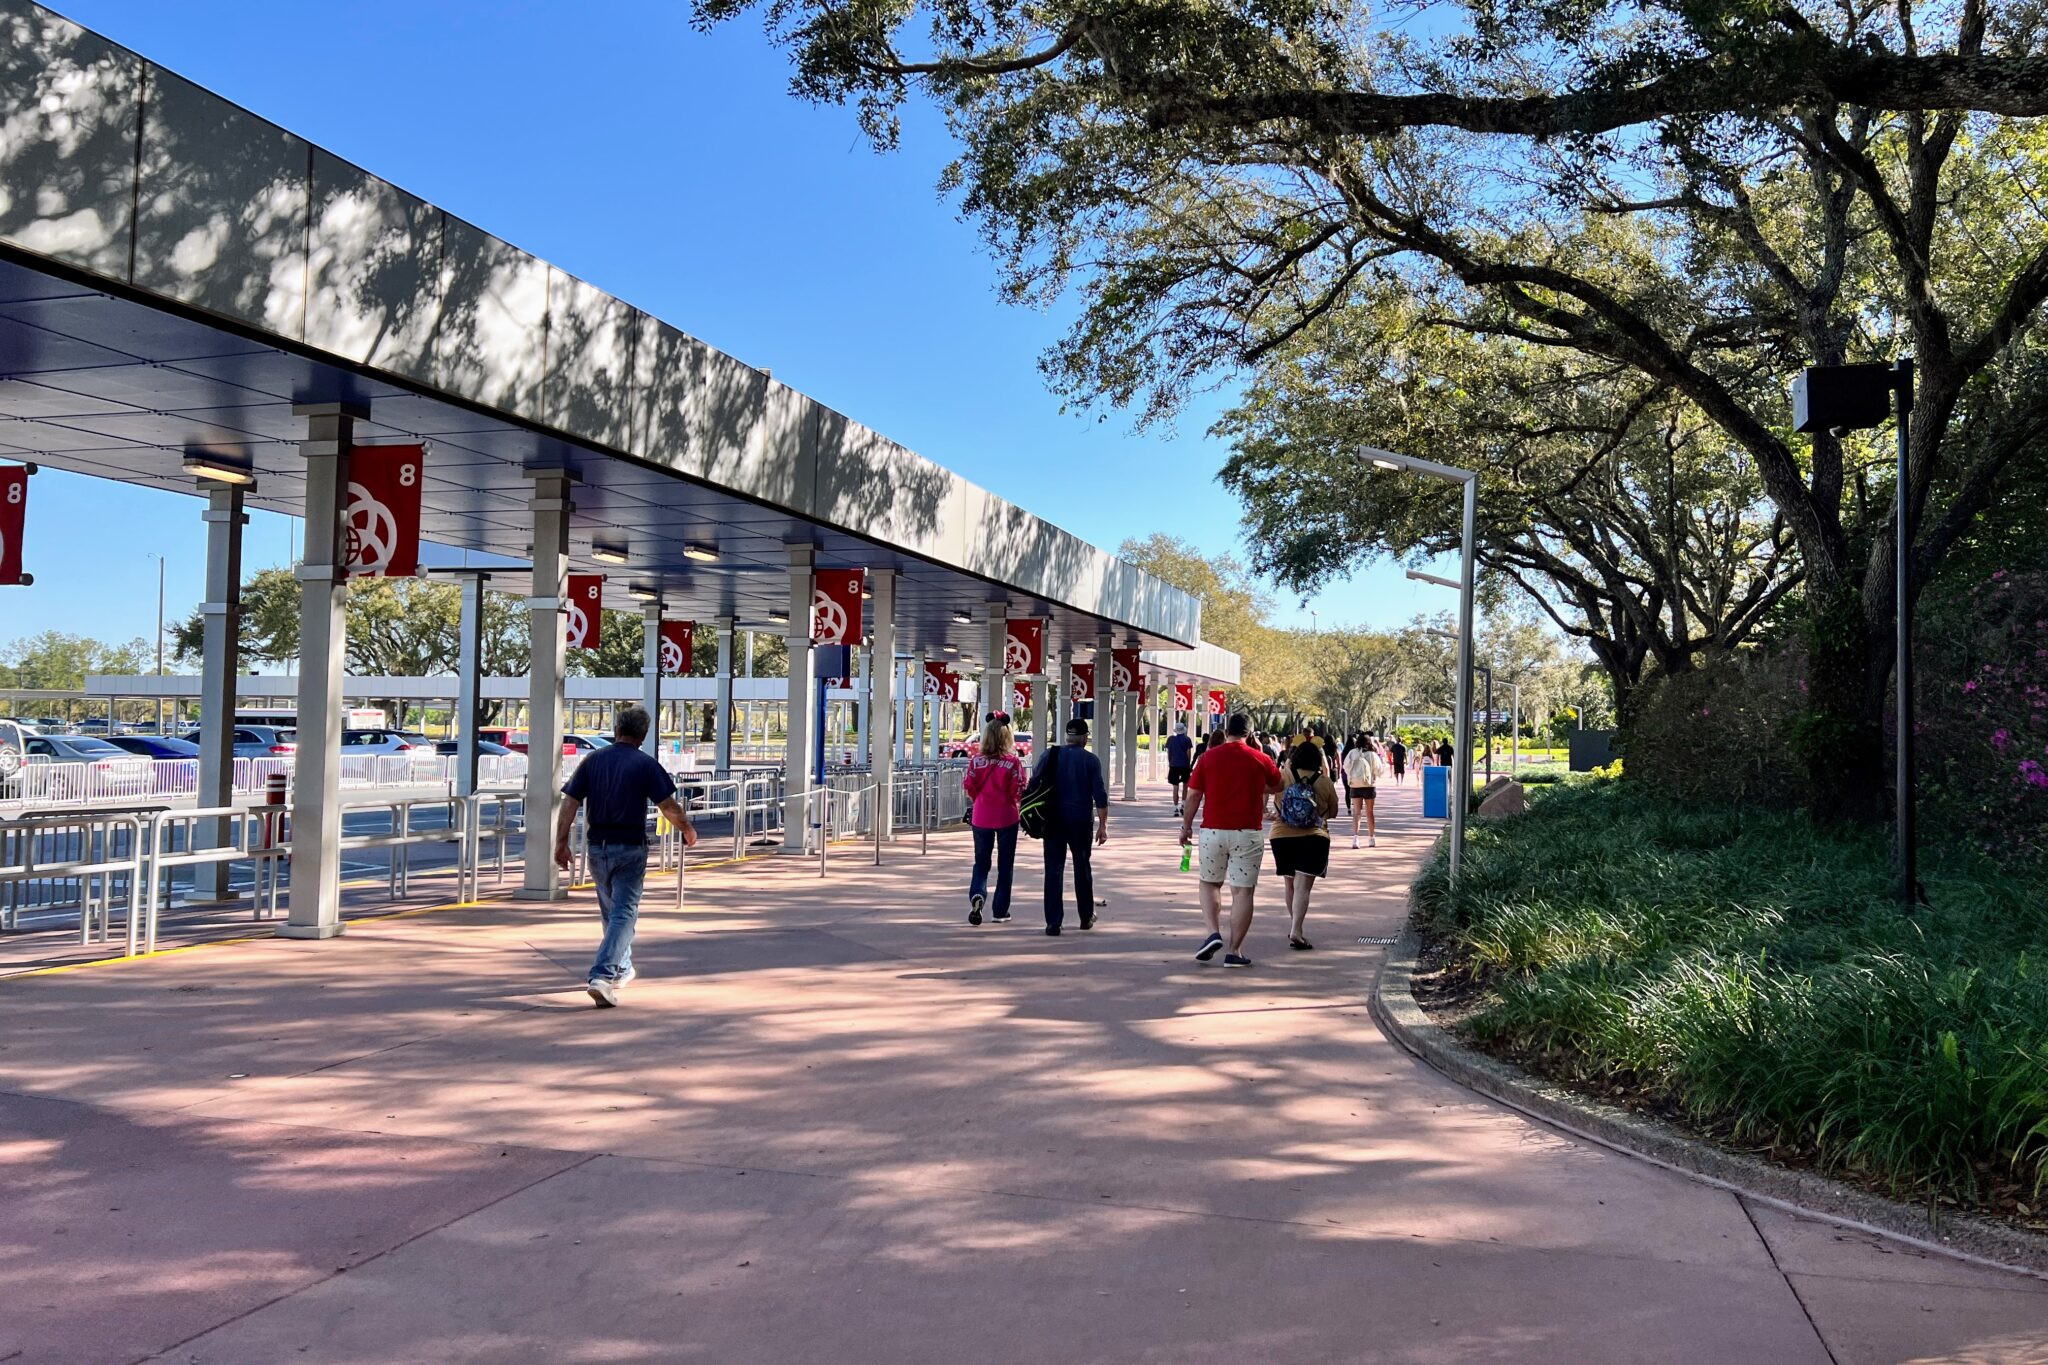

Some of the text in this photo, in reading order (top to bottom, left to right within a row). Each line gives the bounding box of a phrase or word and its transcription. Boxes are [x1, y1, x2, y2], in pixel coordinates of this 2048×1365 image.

[400, 463, 415, 486] 8
[7, 482, 21, 504] 8
[588, 586, 598, 599] 8
[848, 580, 859, 594] 8
[683, 628, 690, 639] 7
[1031, 627, 1039, 638] 7
[1131, 654, 1138, 663] 7
[939, 666, 945, 674] 7
[1086, 668, 1092, 676] 7
